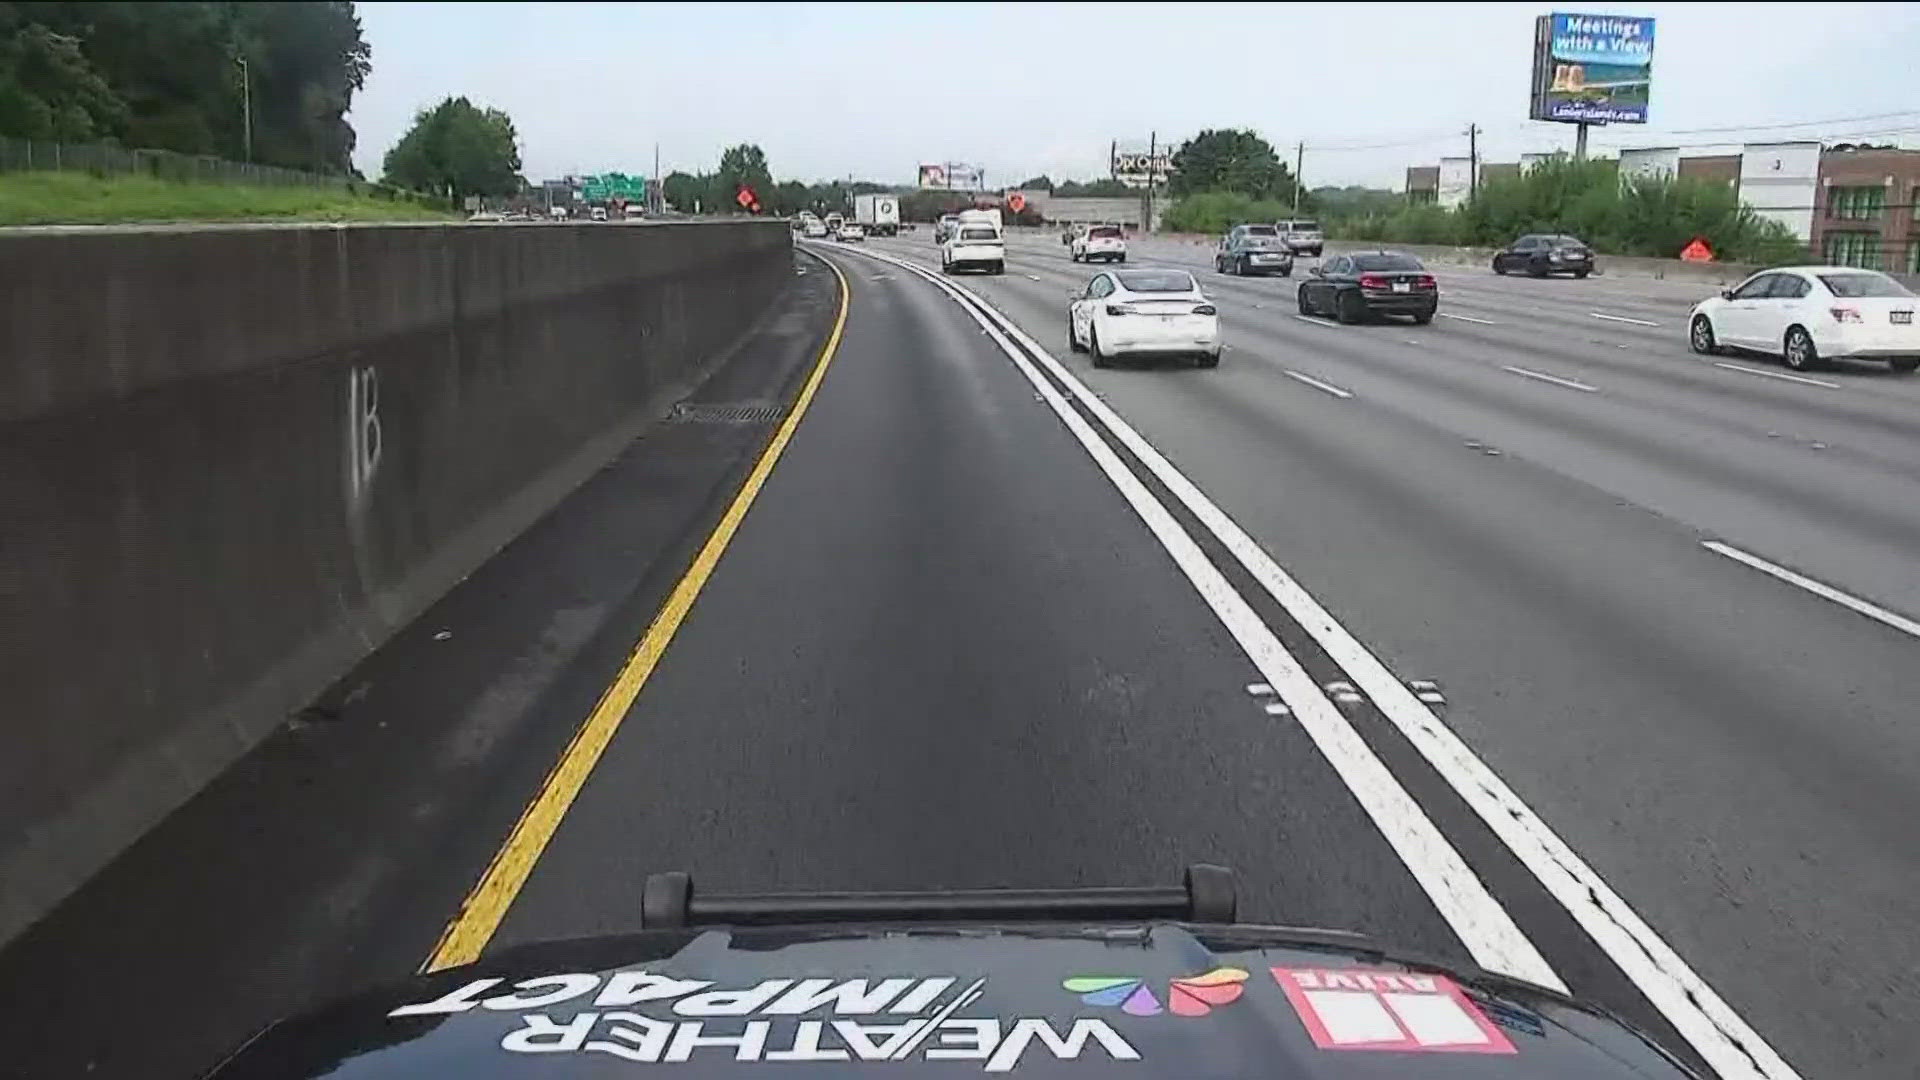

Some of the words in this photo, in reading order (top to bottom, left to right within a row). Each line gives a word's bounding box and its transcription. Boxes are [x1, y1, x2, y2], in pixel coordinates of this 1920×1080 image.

[1567, 17, 1640, 38] Meetings
[1556, 35, 1593, 50] with
[1596, 40, 1606, 51] a
[1610, 38, 1650, 53] View
[1290, 971, 1438, 992] ALIVE
[386, 970, 958, 1017] IMPACT
[500, 1010, 1143, 1073] WEATHER
